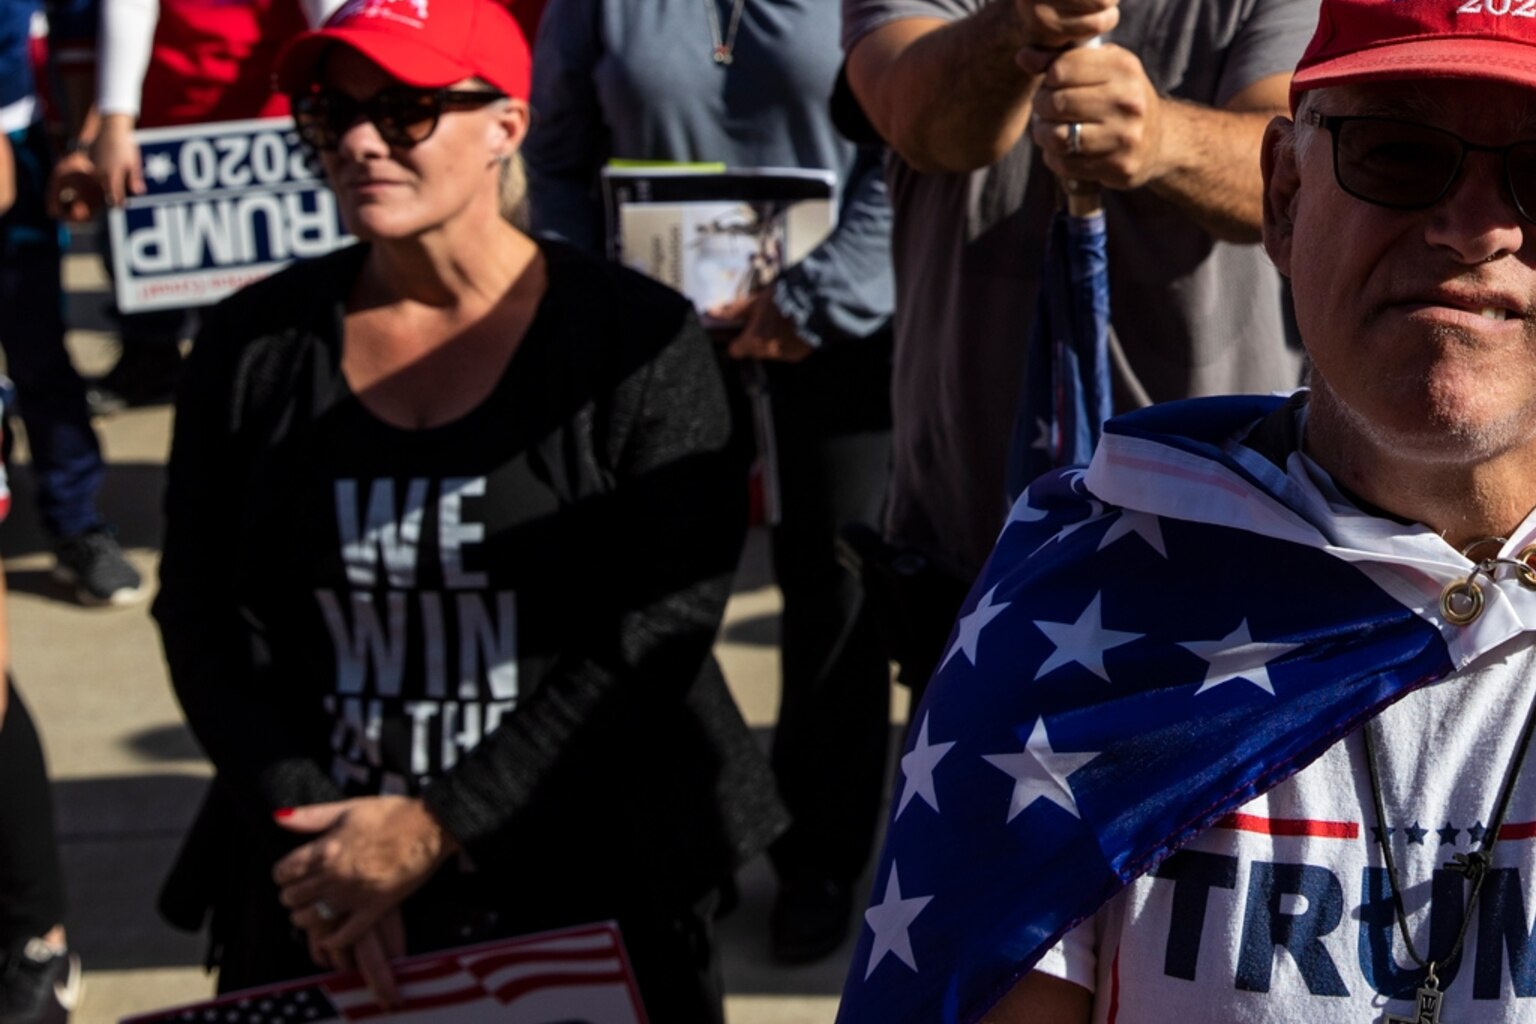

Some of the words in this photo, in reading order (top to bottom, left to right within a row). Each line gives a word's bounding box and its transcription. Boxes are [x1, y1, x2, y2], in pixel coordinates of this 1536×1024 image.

[128, 188, 360, 274] RUMP
[334, 477, 488, 589] WE
[314, 588, 519, 698] WIN
